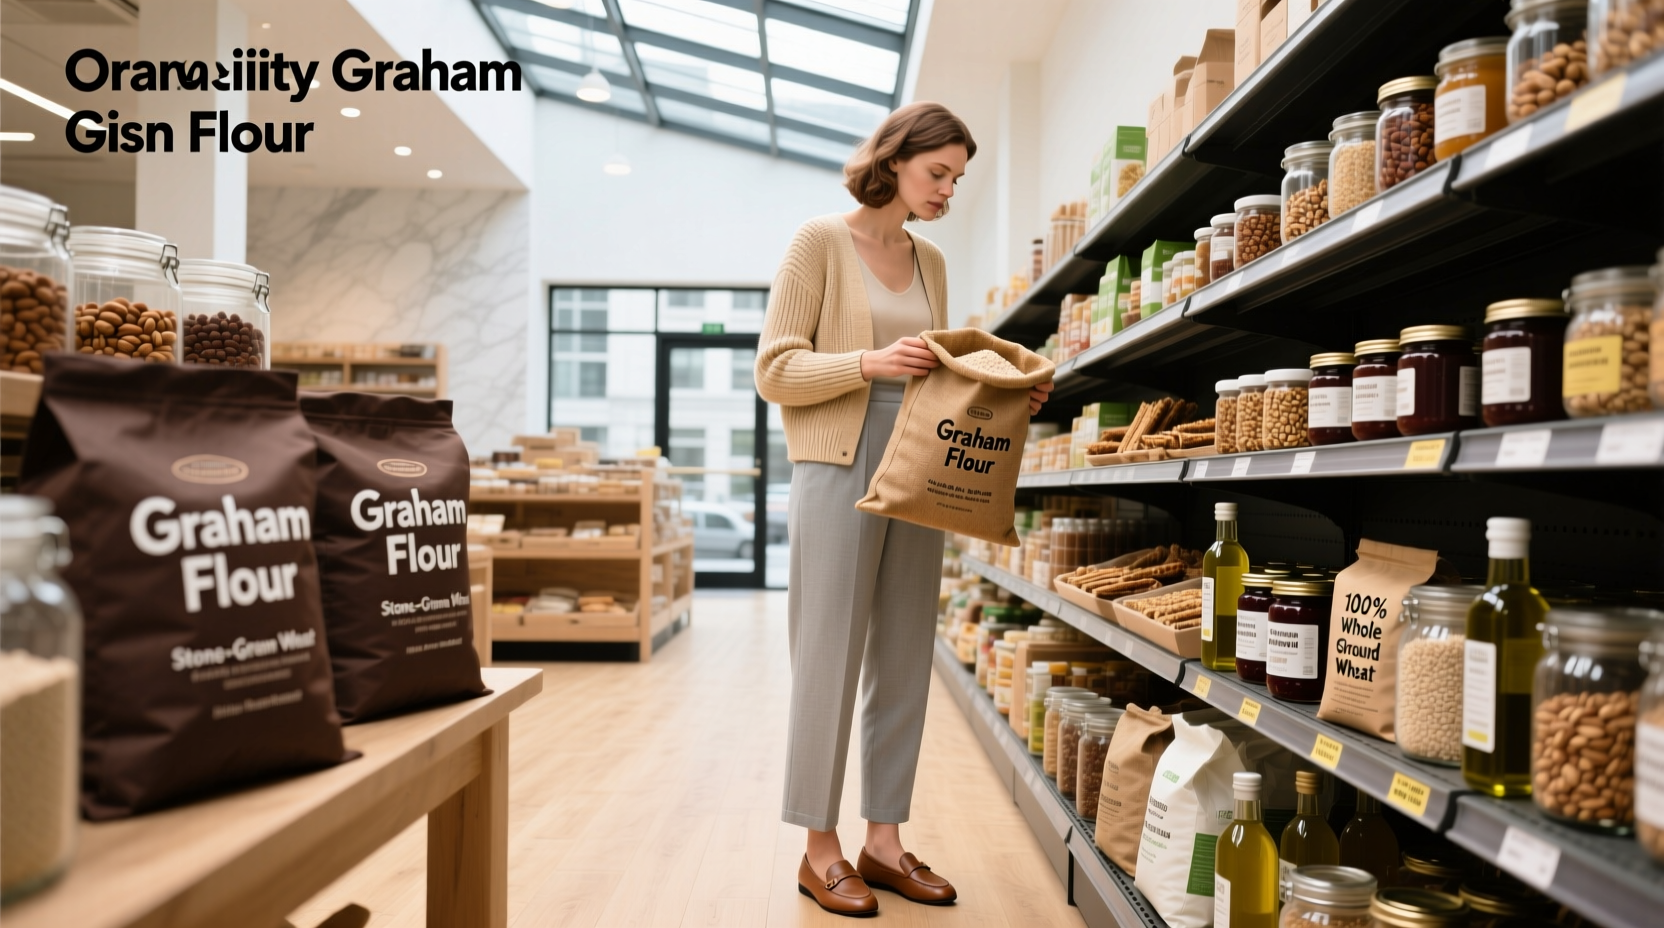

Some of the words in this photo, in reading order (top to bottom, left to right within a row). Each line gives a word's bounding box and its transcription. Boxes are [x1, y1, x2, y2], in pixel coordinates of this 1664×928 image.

[936, 418, 1011, 452] Graham
[944, 446, 995, 474] Flour
[129, 494, 311, 556] Graham
[349, 488, 467, 532] Graham
[386, 532, 462, 576] Flour
[180, 552, 298, 613] Flour
[1345, 592, 1388, 619] 100%
[1341, 616, 1382, 640] Whole
